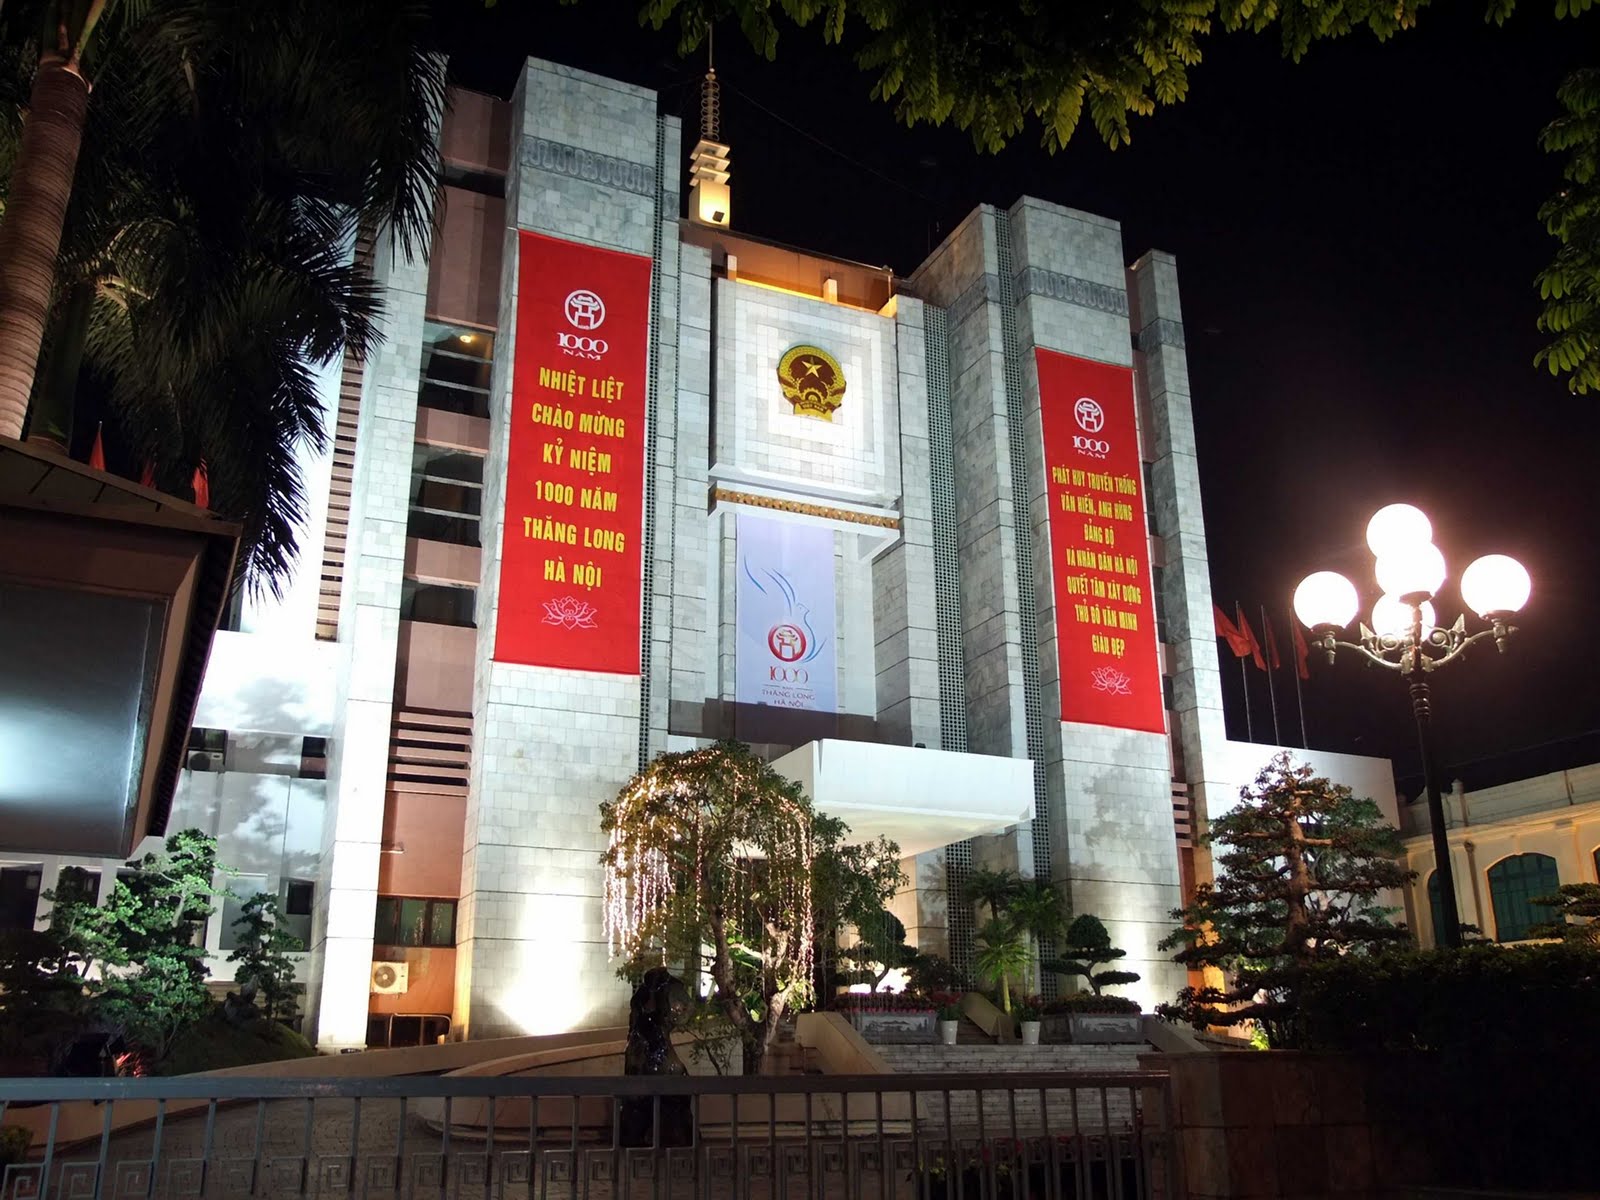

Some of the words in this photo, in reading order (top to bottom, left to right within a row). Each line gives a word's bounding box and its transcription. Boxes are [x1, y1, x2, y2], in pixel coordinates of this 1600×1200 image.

[557, 332, 608, 354] 1000
[539, 367, 586, 397] NHIỆT
[592, 376, 624, 403] LIỆT
[532, 402, 574, 430] CHÀO
[579, 410, 625, 438] MỪNG
[543, 437, 564, 465] KỶ
[570, 446, 611, 476] NIỆM
[1072, 435, 1109, 454] 1000
[535, 480, 574, 506] 1000
[580, 487, 617, 512] NĂM
[1052, 464, 1070, 485] PHÁT
[1072, 469, 1085, 487] HUY
[1114, 473, 1137, 496] THỐNG
[1061, 491, 1076, 513] VĂN
[1098, 500, 1113, 519] ANH
[1114, 500, 1133, 522] HÙNG
[523, 515, 577, 545] THĂNG
[584, 527, 625, 553] LONG
[1084, 518, 1103, 544] ĐẢNG
[1105, 525, 1114, 549] BỘ
[544, 556, 565, 583] HÀ
[573, 561, 601, 591] NỘI
[1066, 545, 1076, 567] VÀ
[1077, 547, 1096, 569] NHÂN
[1098, 551, 1113, 572] DÂN
[1115, 553, 1125, 574] HÀ
[1126, 555, 1138, 579] NỘI
[1067, 572, 1089, 595] QUYẾT
[1090, 576, 1105, 599] TÂM
[1107, 579, 1121, 601] XÂY
[1122, 584, 1141, 606] DỰNG
[1074, 598, 1089, 623] THỦ
[1090, 603, 1101, 625] ĐÔ
[1102, 606, 1117, 627] VĂN
[1119, 611, 1138, 631] MINH
[1091, 632, 1109, 654] GIÀU
[1111, 637, 1125, 659] ĐẸP
[792, 692, 815, 700] LONG
